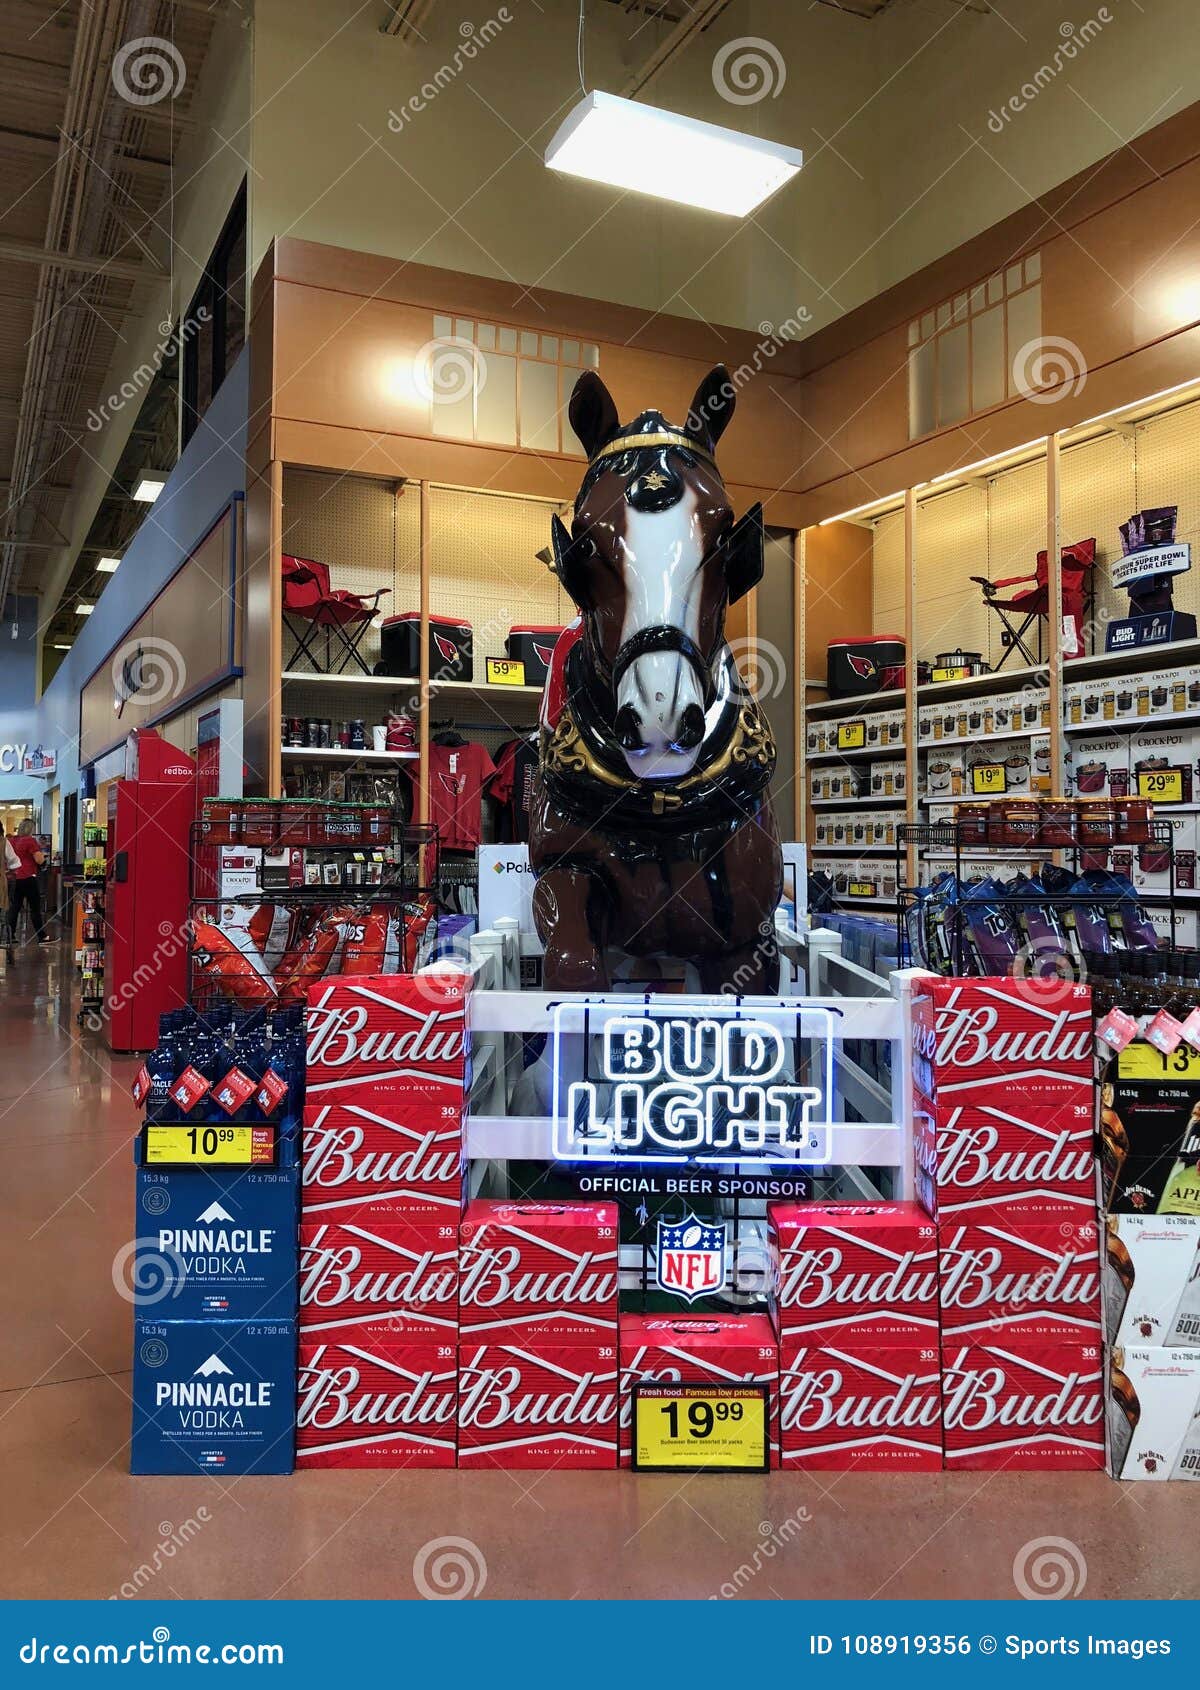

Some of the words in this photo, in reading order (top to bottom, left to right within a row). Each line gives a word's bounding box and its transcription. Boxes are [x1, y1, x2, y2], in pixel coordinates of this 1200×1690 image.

[1135, 555, 1159, 566] SUPER
[1161, 551, 1186, 560] BOWL
[1140, 563, 1153, 571] FOR
[1116, 627, 1133, 636] BUD
[1112, 633, 1136, 643] LIGHT
[164, 767, 193, 775] redbox
[444, 987, 458, 997] 30
[1073, 986, 1087, 996] 30
[604, 1017, 785, 1084] BUD
[441, 1107, 455, 1116] 30
[568, 1082, 822, 1149] LIGHT
[1073, 1106, 1088, 1116] 30
[143, 1174, 158, 1183] 15.3
[160, 1174, 169, 1184] kg
[248, 1174, 256, 1183] 12
[264, 1174, 277, 1183] 750
[579, 1177, 660, 1194] OFFICIAL
[666, 1178, 713, 1195] BEER
[718, 1179, 807, 1197] SPONSOR
[438, 1227, 452, 1236] 30
[597, 1227, 611, 1237] 30
[918, 1227, 932, 1237] 30
[1078, 1227, 1093, 1237] 30
[159, 1229, 273, 1253] PINNACLE
[182, 1256, 246, 1274] VODKA
[664, 1252, 718, 1290] NFL
[142, 1326, 156, 1335] 15.3
[157, 1326, 167, 1336] kg
[247, 1326, 255, 1335] 12
[263, 1326, 277, 1335] 750
[437, 1347, 451, 1357] 30
[598, 1347, 612, 1357] 30
[758, 1348, 772, 1357] 30
[920, 1350, 934, 1359] 30
[1082, 1348, 1096, 1358] 30
[156, 1382, 272, 1407] PINNACLE
[639, 1388, 662, 1396] Fresh
[663, 1388, 684, 1396] food.
[685, 1388, 716, 1397] Famous
[718, 1388, 730, 1396] low
[733, 1388, 761, 1398] prices.
[179, 1410, 244, 1429] VODKA
